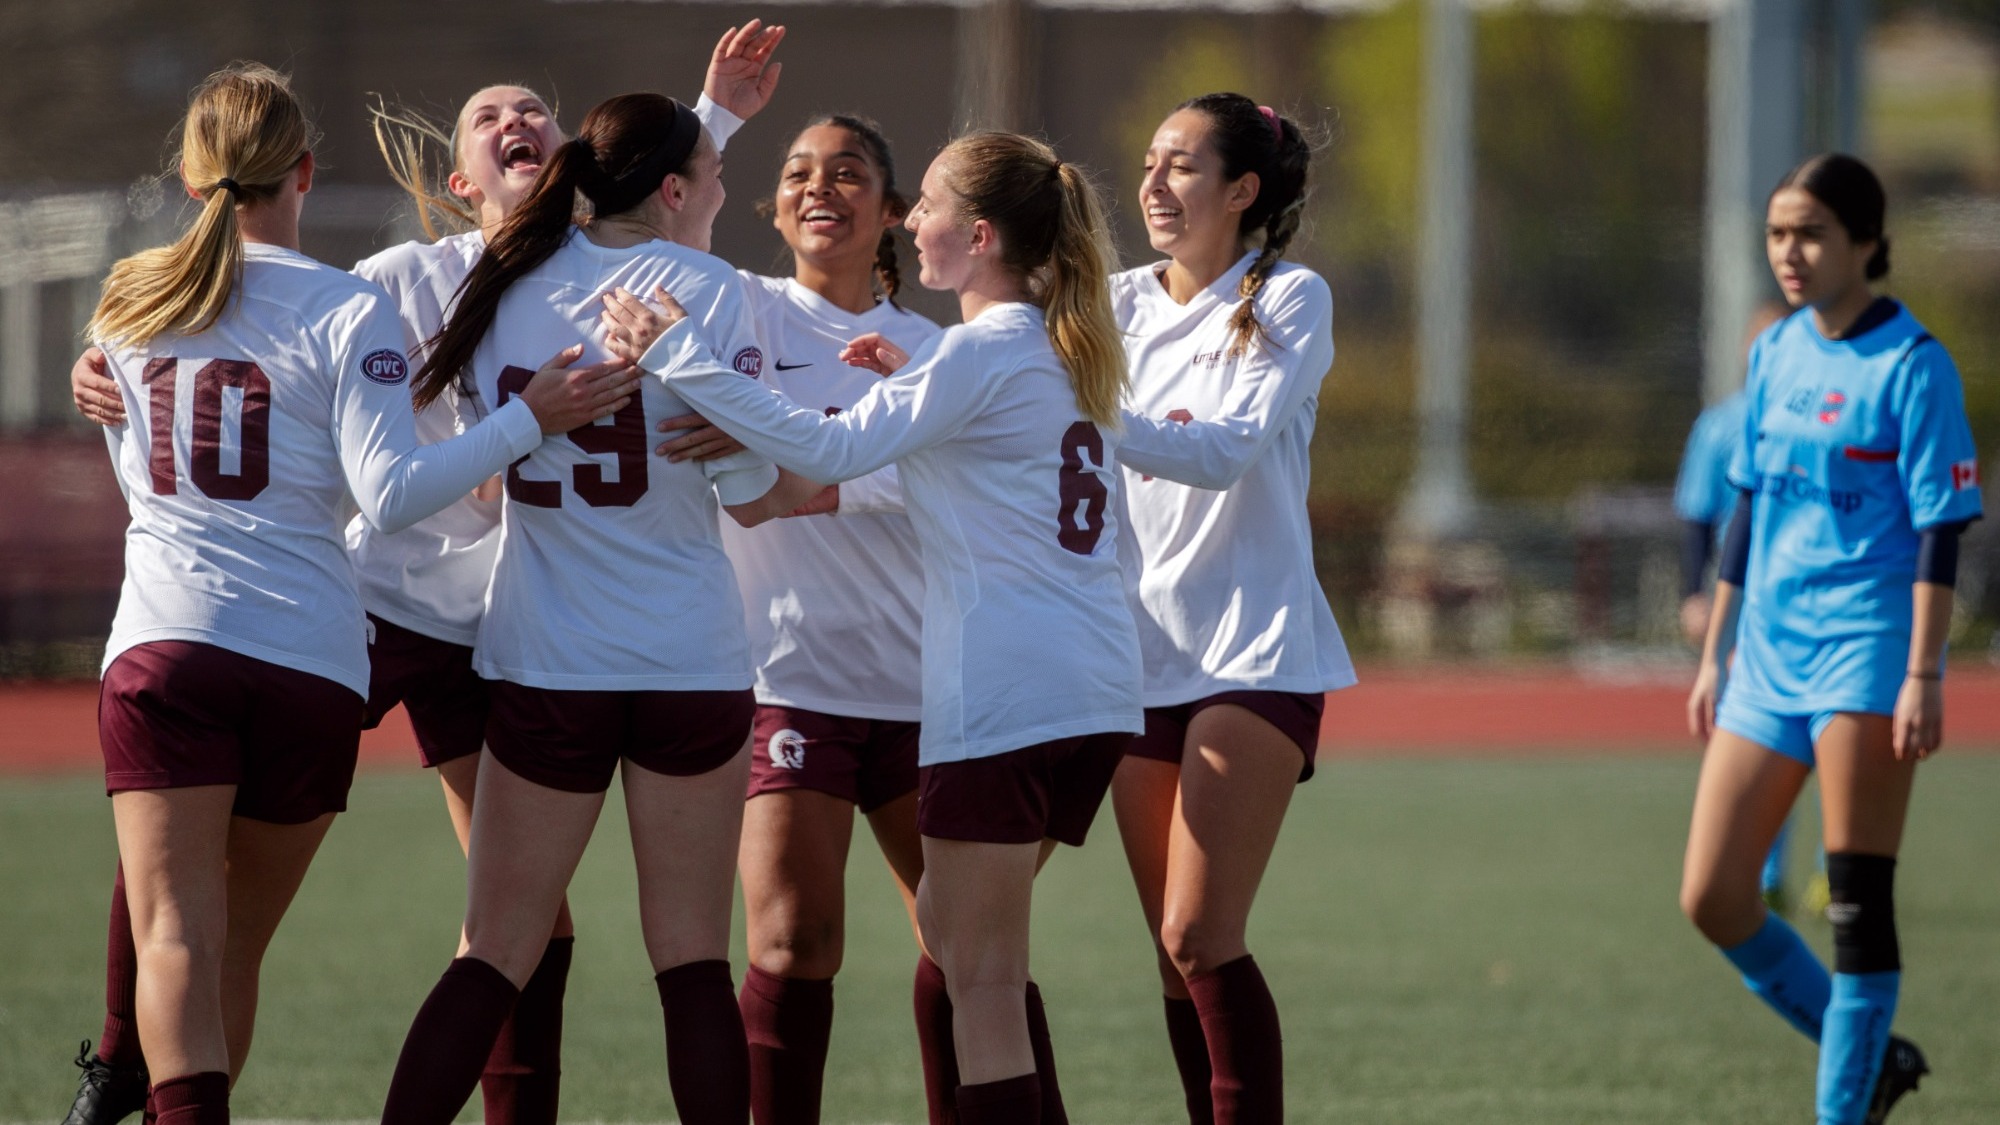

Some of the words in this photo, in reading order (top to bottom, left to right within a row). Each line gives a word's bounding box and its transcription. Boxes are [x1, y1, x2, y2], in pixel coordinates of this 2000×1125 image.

[740, 356, 760, 371] OVC
[1193, 350, 1222, 364] LITTLE
[372, 359, 400, 375] OVC
[141, 357, 271, 501] 10
[1057, 421, 1108, 555] 6
